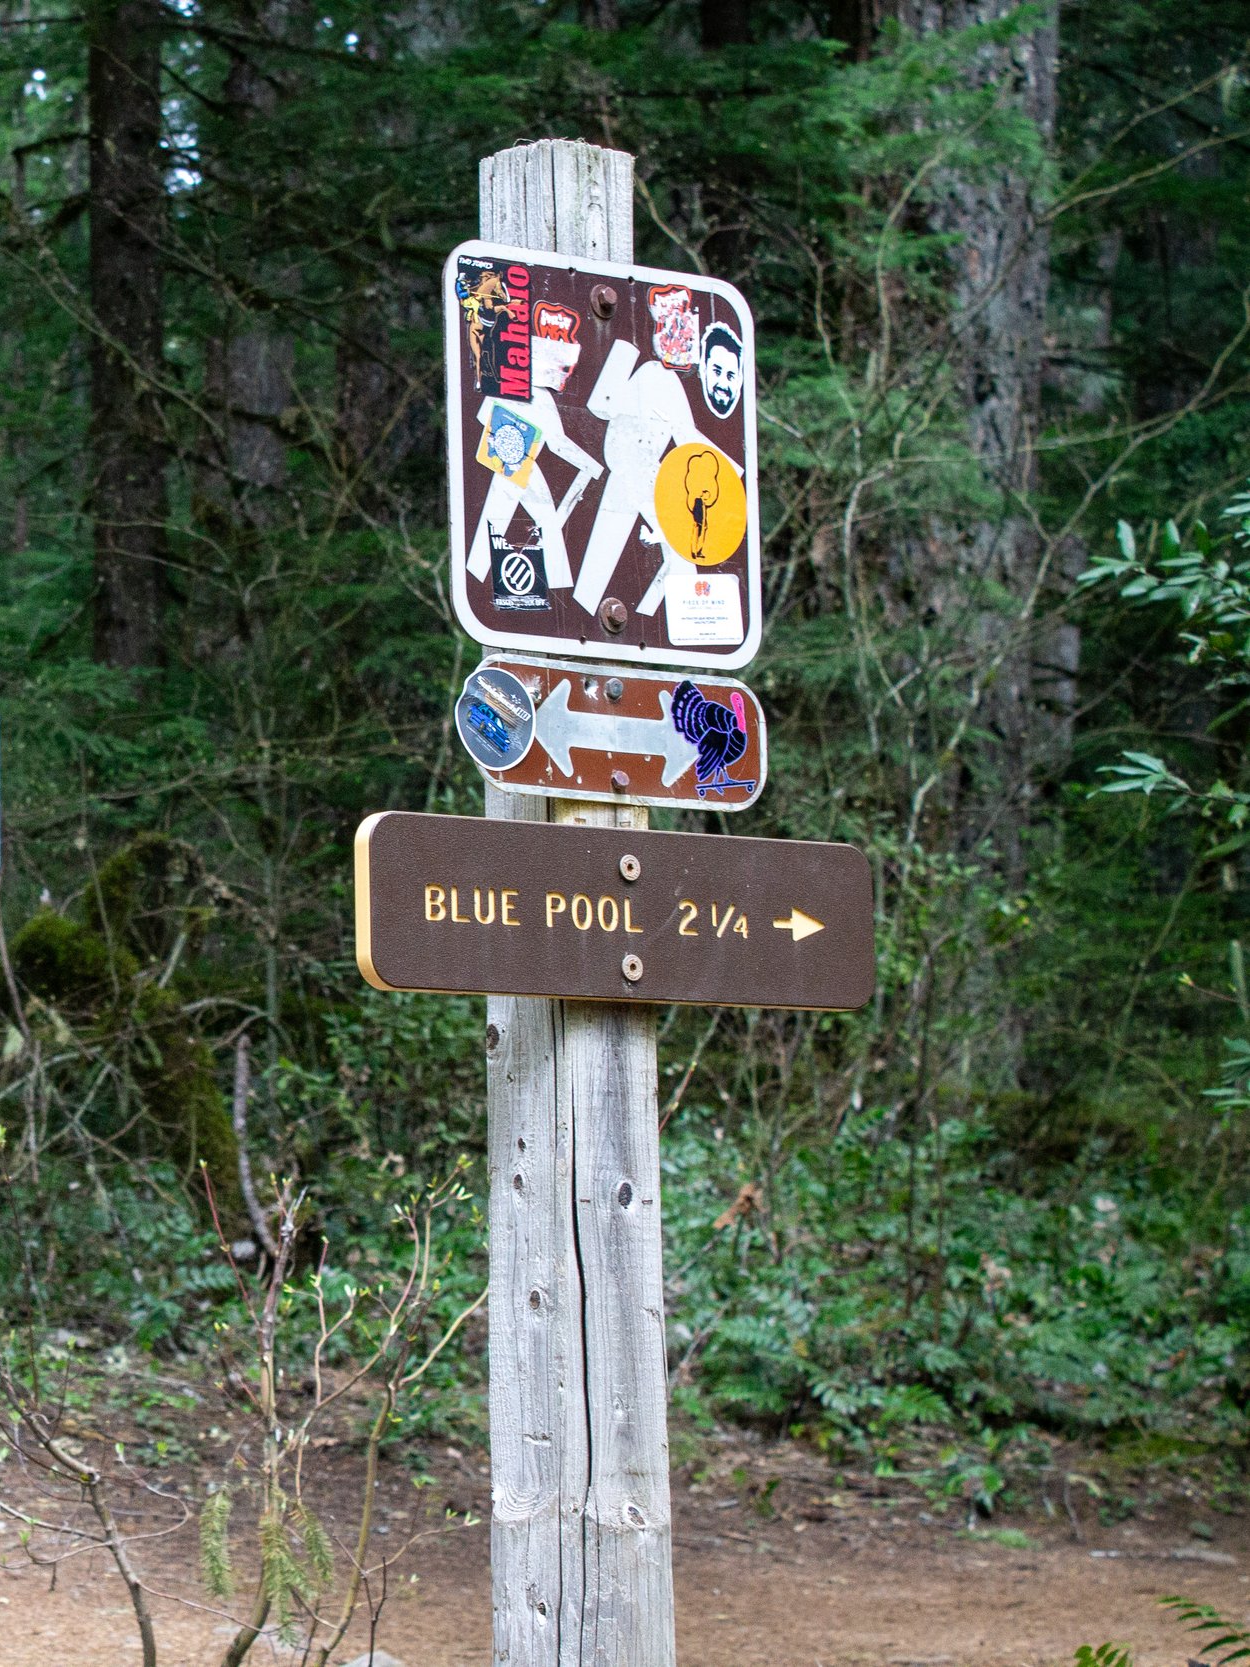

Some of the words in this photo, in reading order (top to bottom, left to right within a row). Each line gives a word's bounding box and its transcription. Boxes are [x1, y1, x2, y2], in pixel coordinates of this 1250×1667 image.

[500, 265, 530, 399] Mahalo
[424, 882, 521, 927] BLUE
[546, 890, 644, 934] POOL
[677, 898, 699, 937] 2
